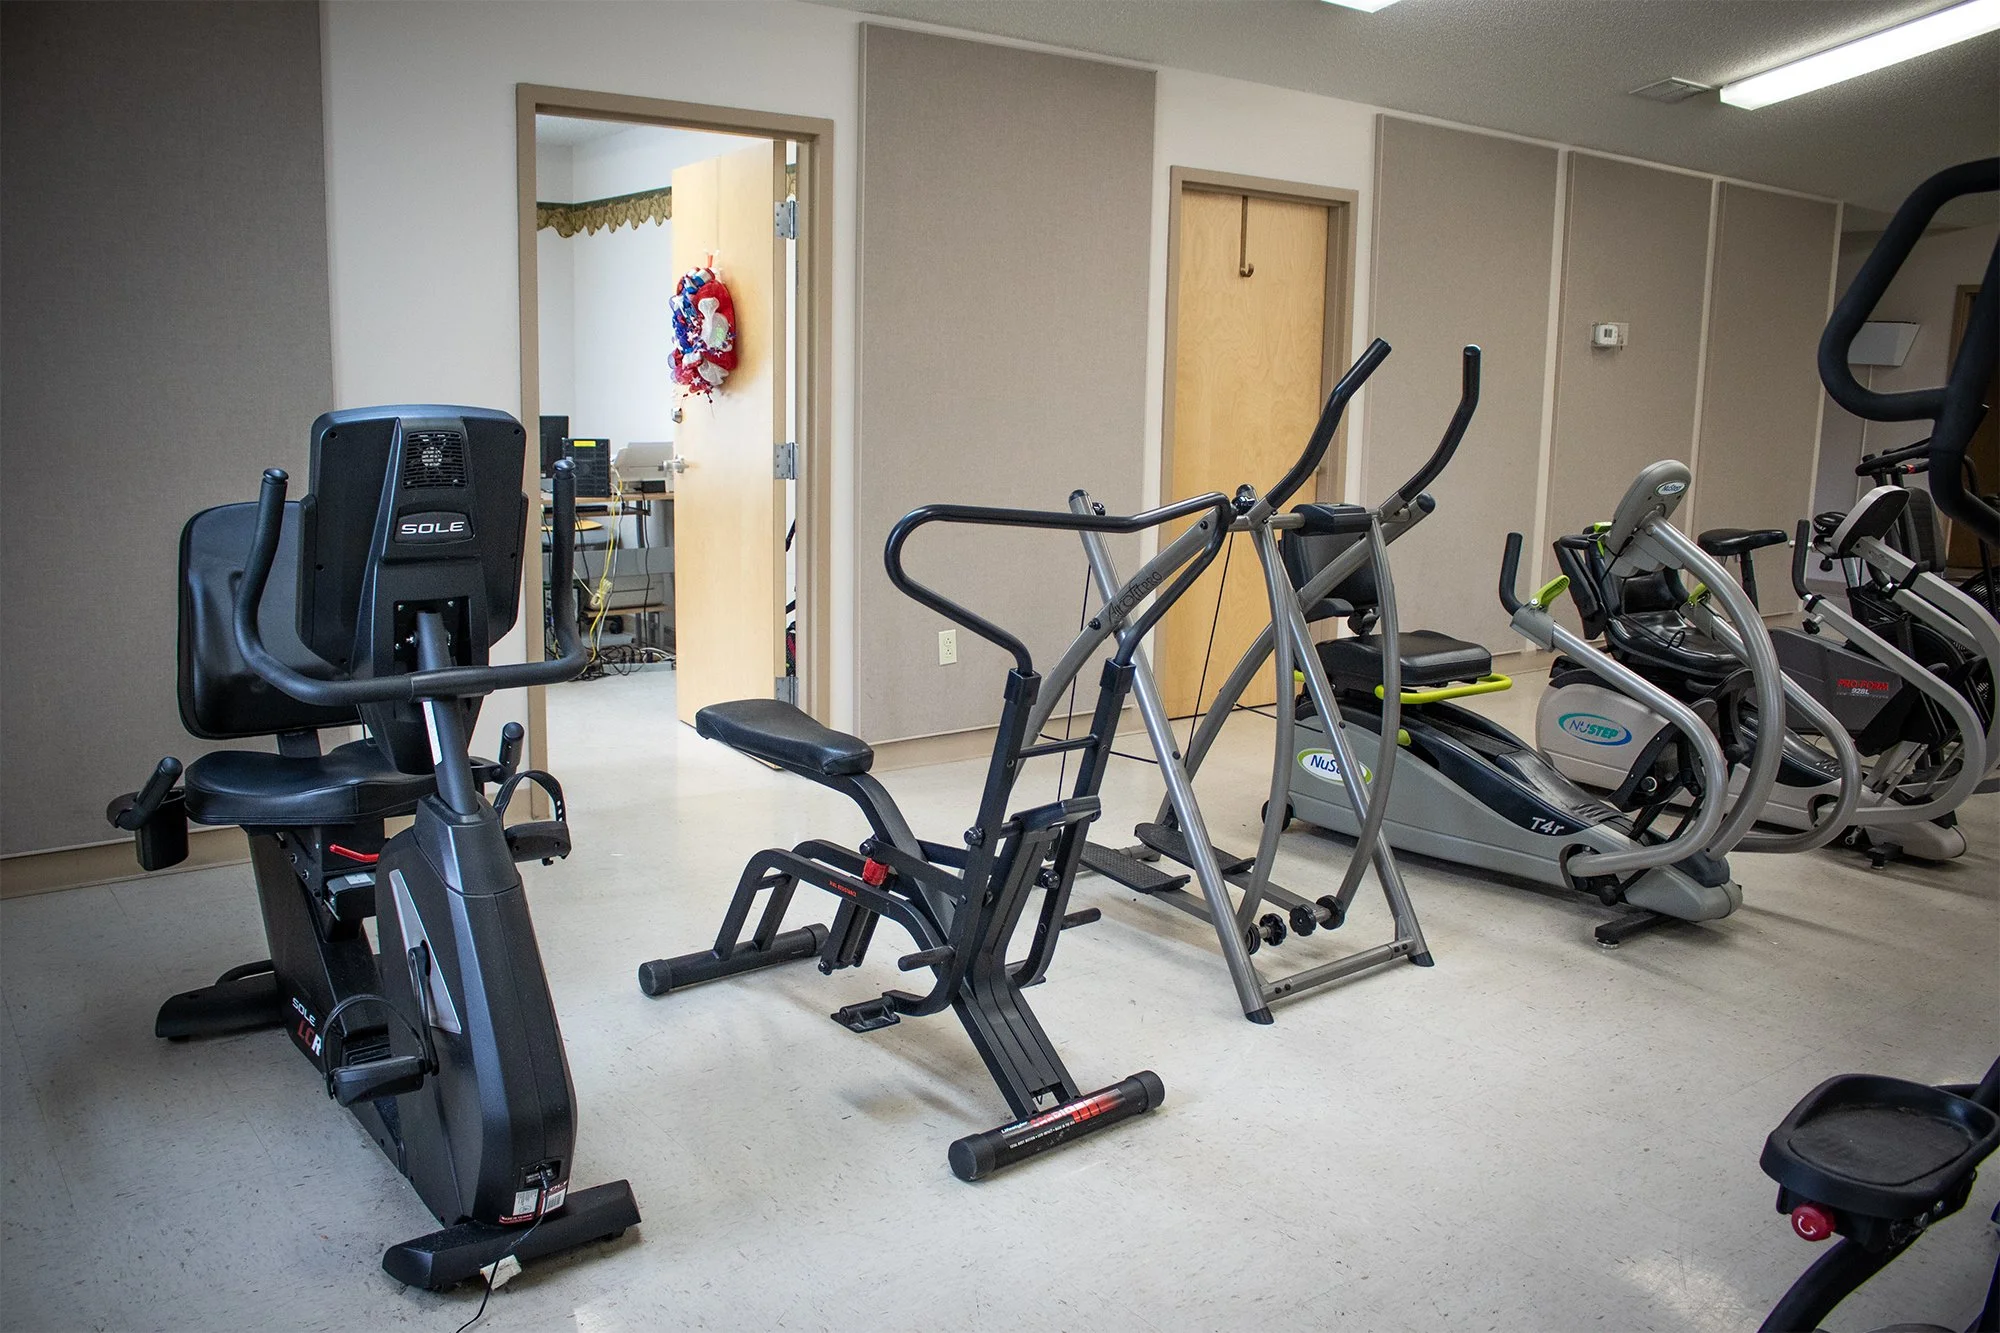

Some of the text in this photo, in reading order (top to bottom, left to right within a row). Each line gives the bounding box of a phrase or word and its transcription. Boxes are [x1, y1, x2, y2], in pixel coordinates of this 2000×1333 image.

[400, 521, 465, 535] SOLE
[1310, 754, 1341, 775] NuS
[1531, 816, 1565, 835] T4r
[292, 997, 316, 1027] SOLE
[297, 1019, 322, 1057] LCR
